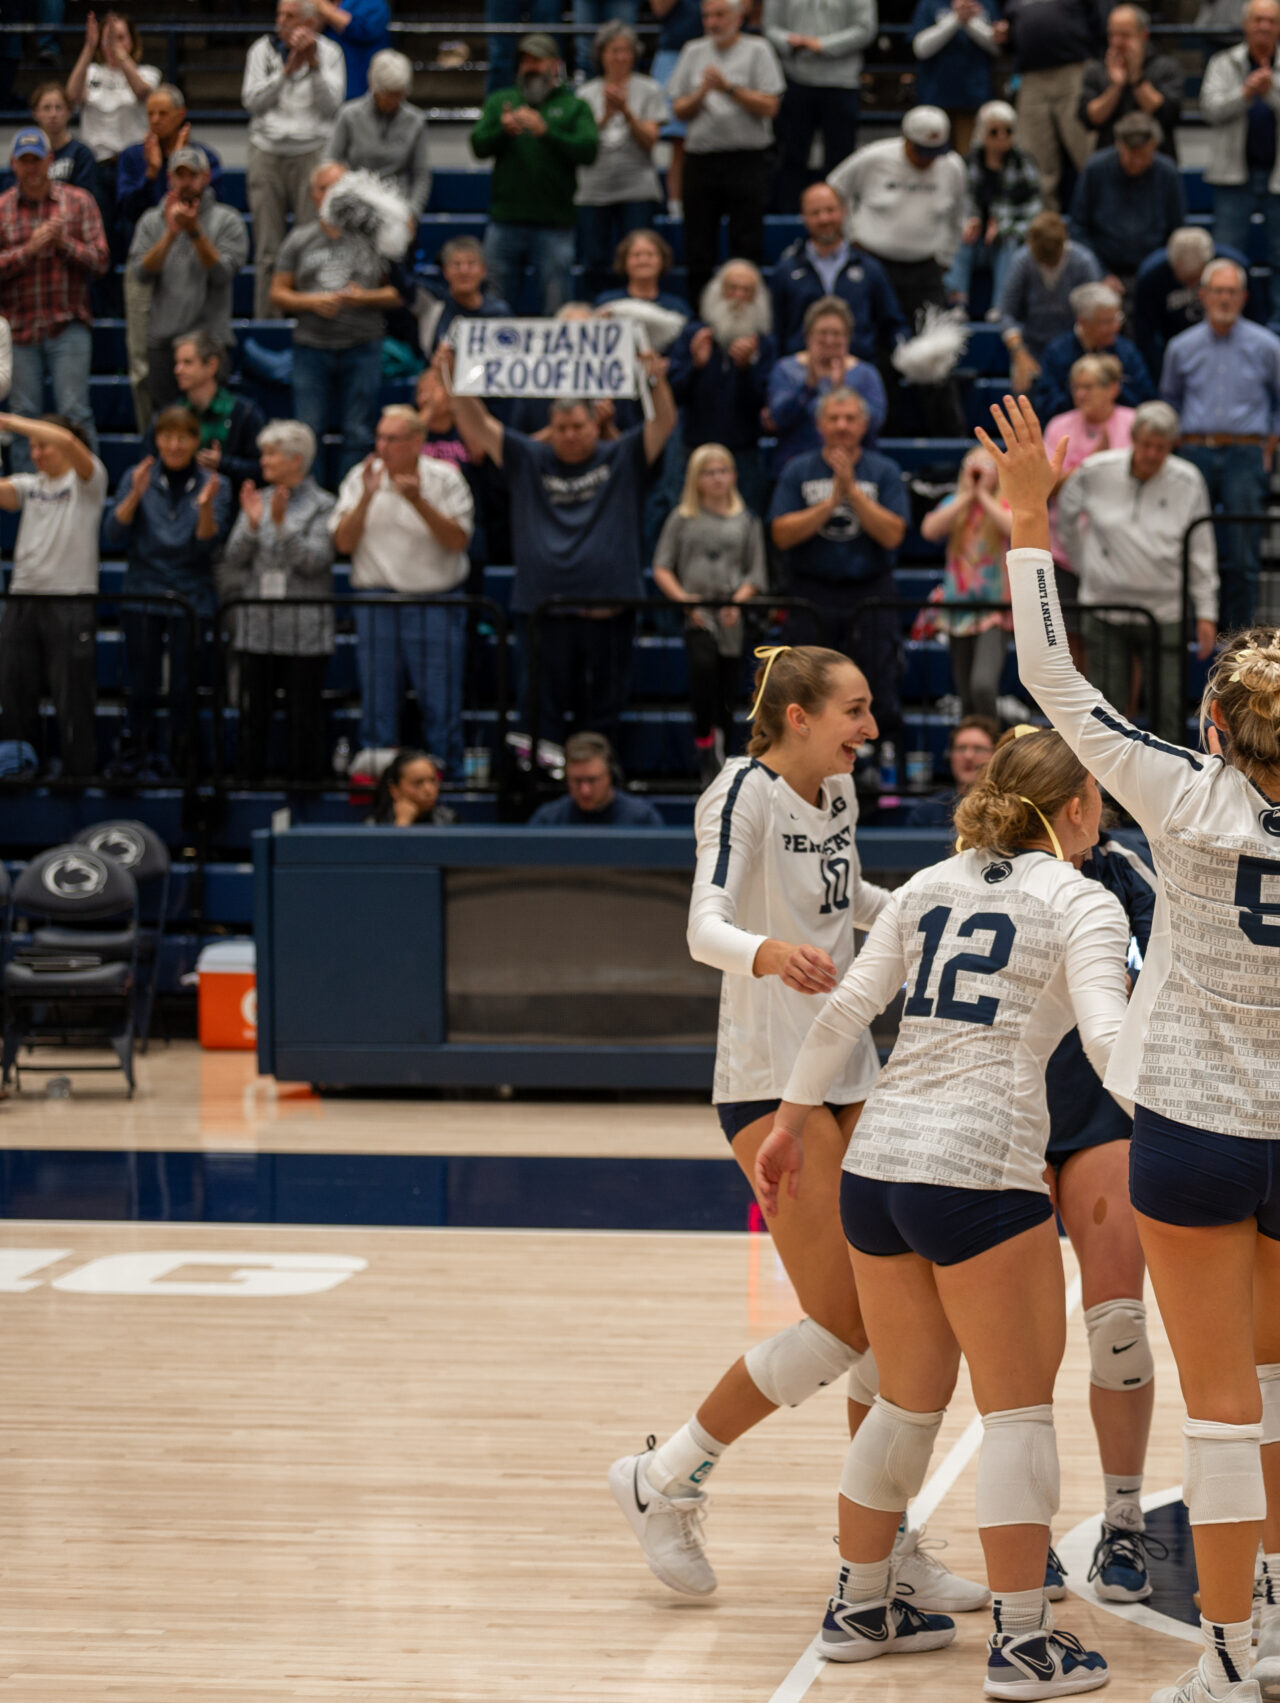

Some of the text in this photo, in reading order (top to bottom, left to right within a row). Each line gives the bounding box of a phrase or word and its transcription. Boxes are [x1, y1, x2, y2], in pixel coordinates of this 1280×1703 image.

[485, 359, 625, 391] ROOFING
[1036, 568, 1057, 647] NITTANY LIONS
[819, 858, 850, 914] 10
[904, 905, 1017, 1026] 12
